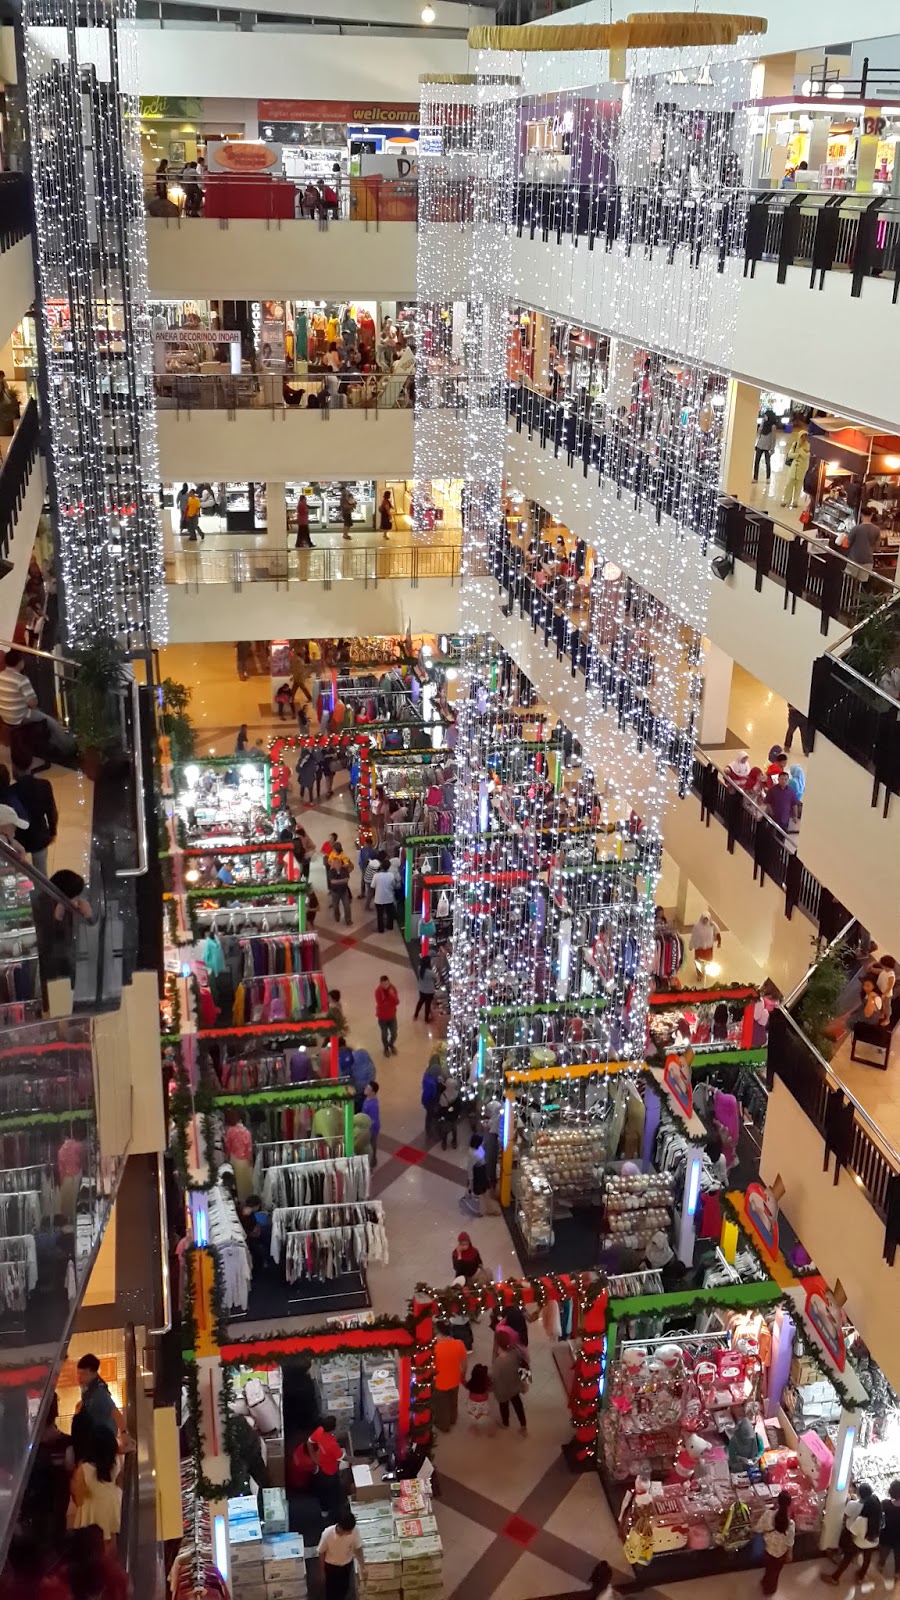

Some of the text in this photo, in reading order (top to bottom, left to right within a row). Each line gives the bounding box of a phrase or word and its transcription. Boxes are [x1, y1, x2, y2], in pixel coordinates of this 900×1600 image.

[353, 107, 420, 121] wellcomm
[863, 116, 886, 135] BR
[155, 331, 239, 342] ANEKA DECORINDO INDAH
